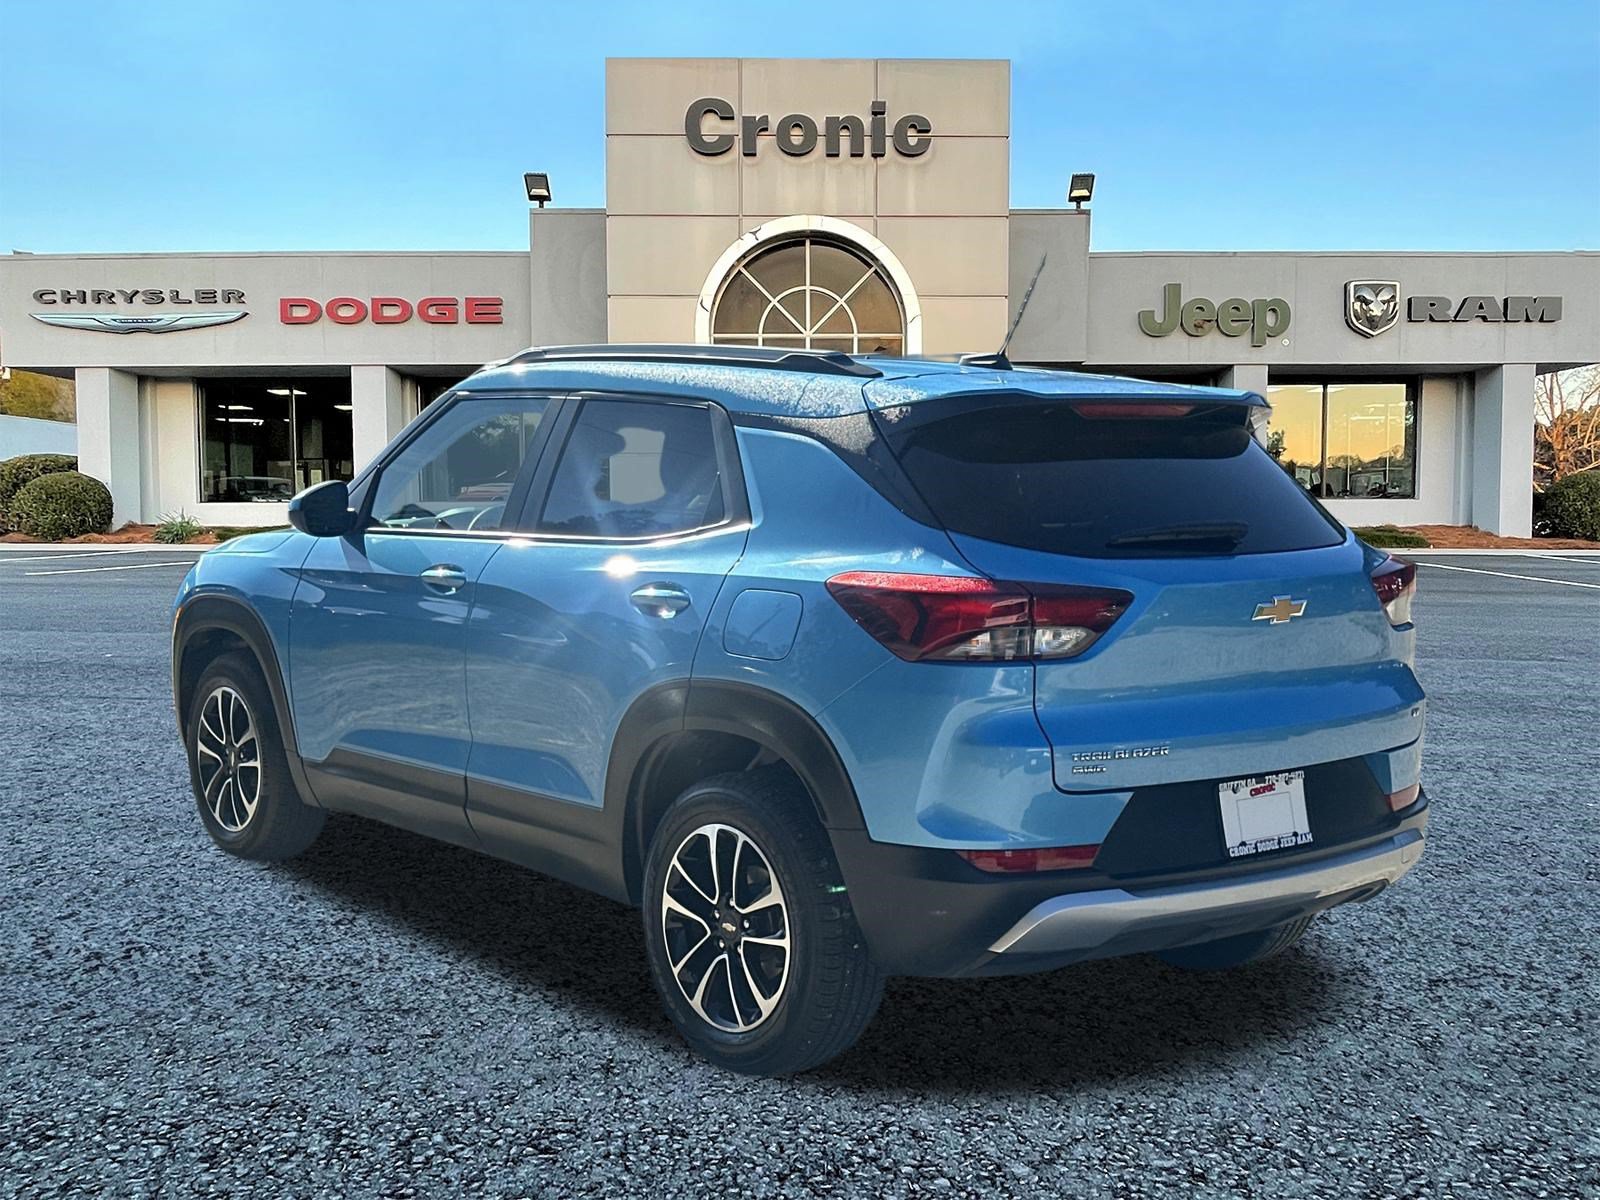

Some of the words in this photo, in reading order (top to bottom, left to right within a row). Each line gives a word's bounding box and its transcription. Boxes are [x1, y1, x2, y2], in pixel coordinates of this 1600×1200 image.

[684, 97, 932, 158] Cronic
[32, 287, 247, 305] CHRYSLER
[1407, 296, 1563, 323] RAM
[280, 297, 504, 325] DODGE
[1138, 283, 1292, 347] Jeep
[1229, 844, 1256, 858] CRONIC
[1257, 839, 1280, 853] DODGE
[1280, 836, 1297, 848] JEEP
